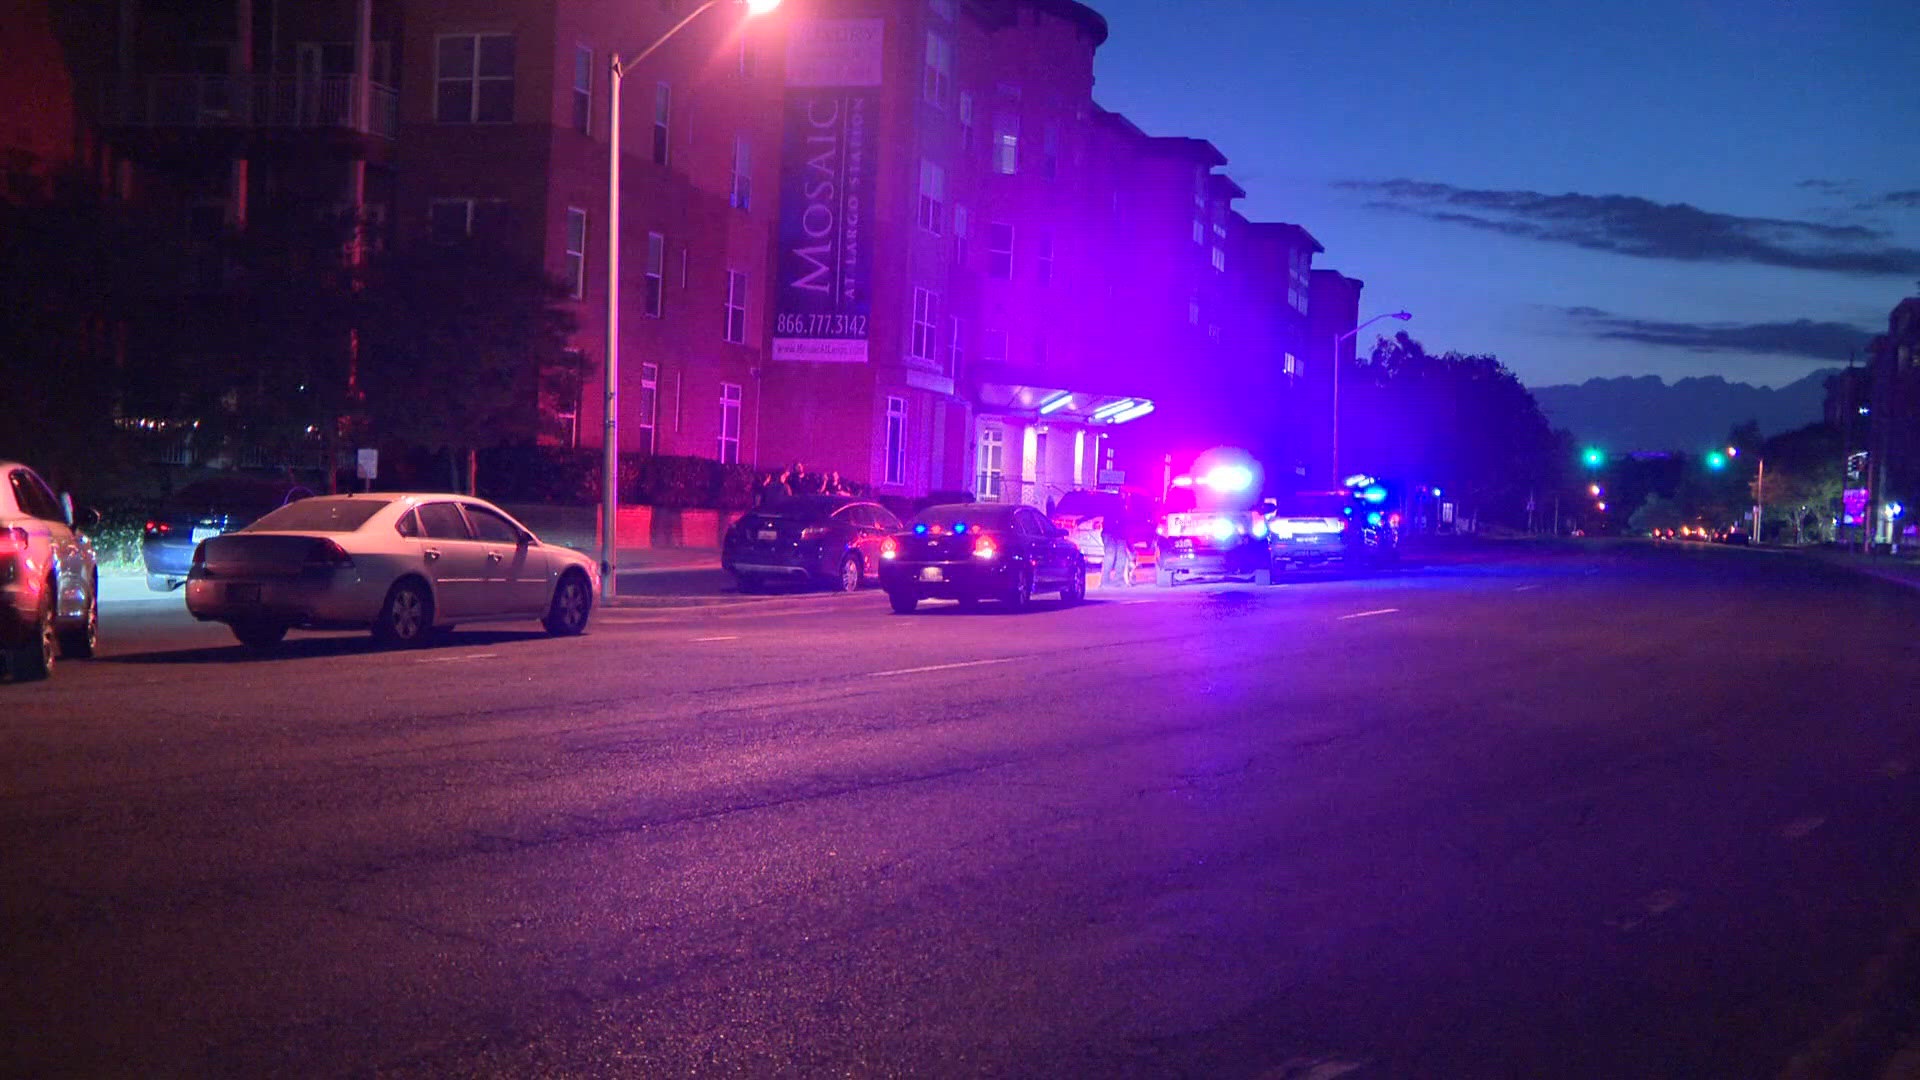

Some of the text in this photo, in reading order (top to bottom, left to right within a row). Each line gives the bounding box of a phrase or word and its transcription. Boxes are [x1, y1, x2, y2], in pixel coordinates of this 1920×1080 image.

[791, 99, 838, 294] MOSAIC
[844, 97, 865, 300] AT LARGO STATION
[777, 313, 867, 336] 866.777.3142
